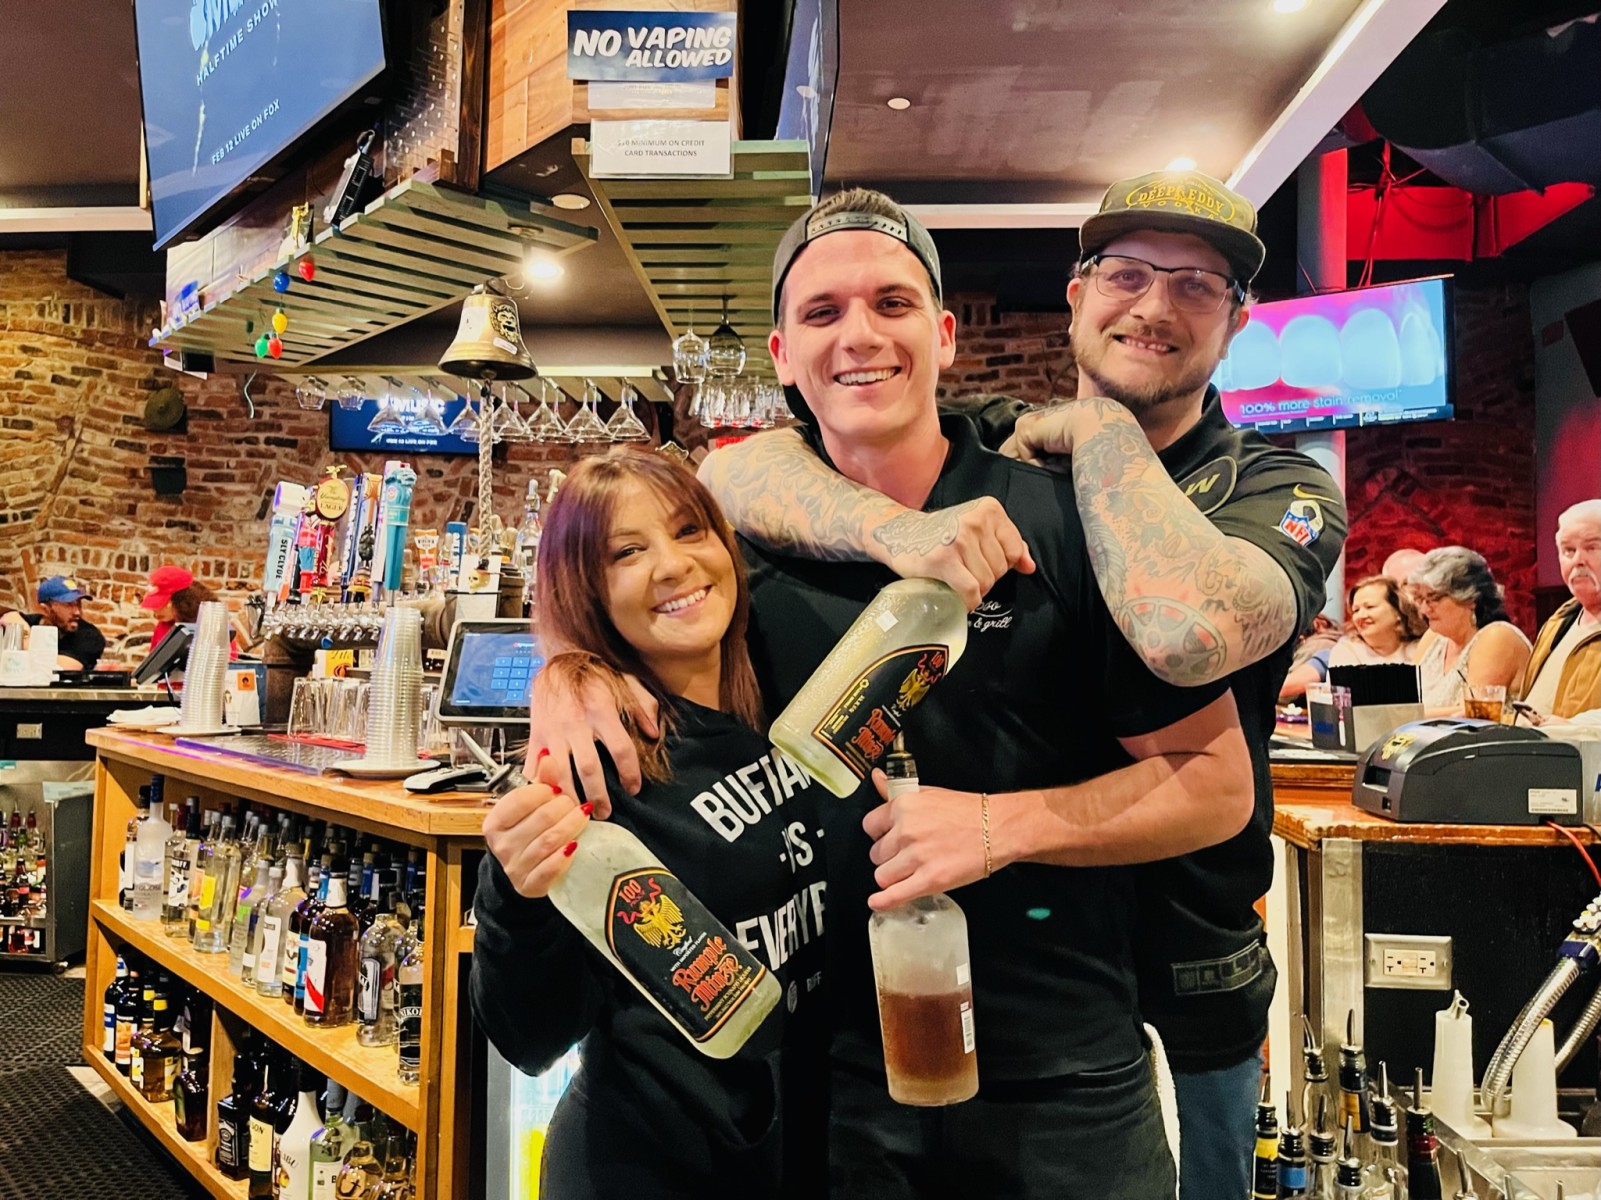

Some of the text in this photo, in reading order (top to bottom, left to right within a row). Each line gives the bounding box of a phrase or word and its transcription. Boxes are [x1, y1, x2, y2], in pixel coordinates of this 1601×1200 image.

[196, 28, 243, 86] HALFTIME
[247, 0, 278, 32] SHOW
[573, 26, 732, 57] NO VAPING
[625, 48, 732, 68] ALLOWED
[212, 99, 279, 165] FEB 12 LIVE ON FOX
[1138, 186, 1176, 202] DEEP
[1188, 188, 1224, 213] EDDY
[1240, 403, 1276, 414] 100%
[1279, 399, 1311, 411] more
[1314, 394, 1344, 408] stain
[276, 539, 288, 579] SLY CLYDE
[974, 617, 982, 628] &
[980, 616, 1012, 632] grill
[619, 879, 641, 903] 100
[672, 936, 726, 992] Rumple
[690, 953, 738, 1012] Minze
